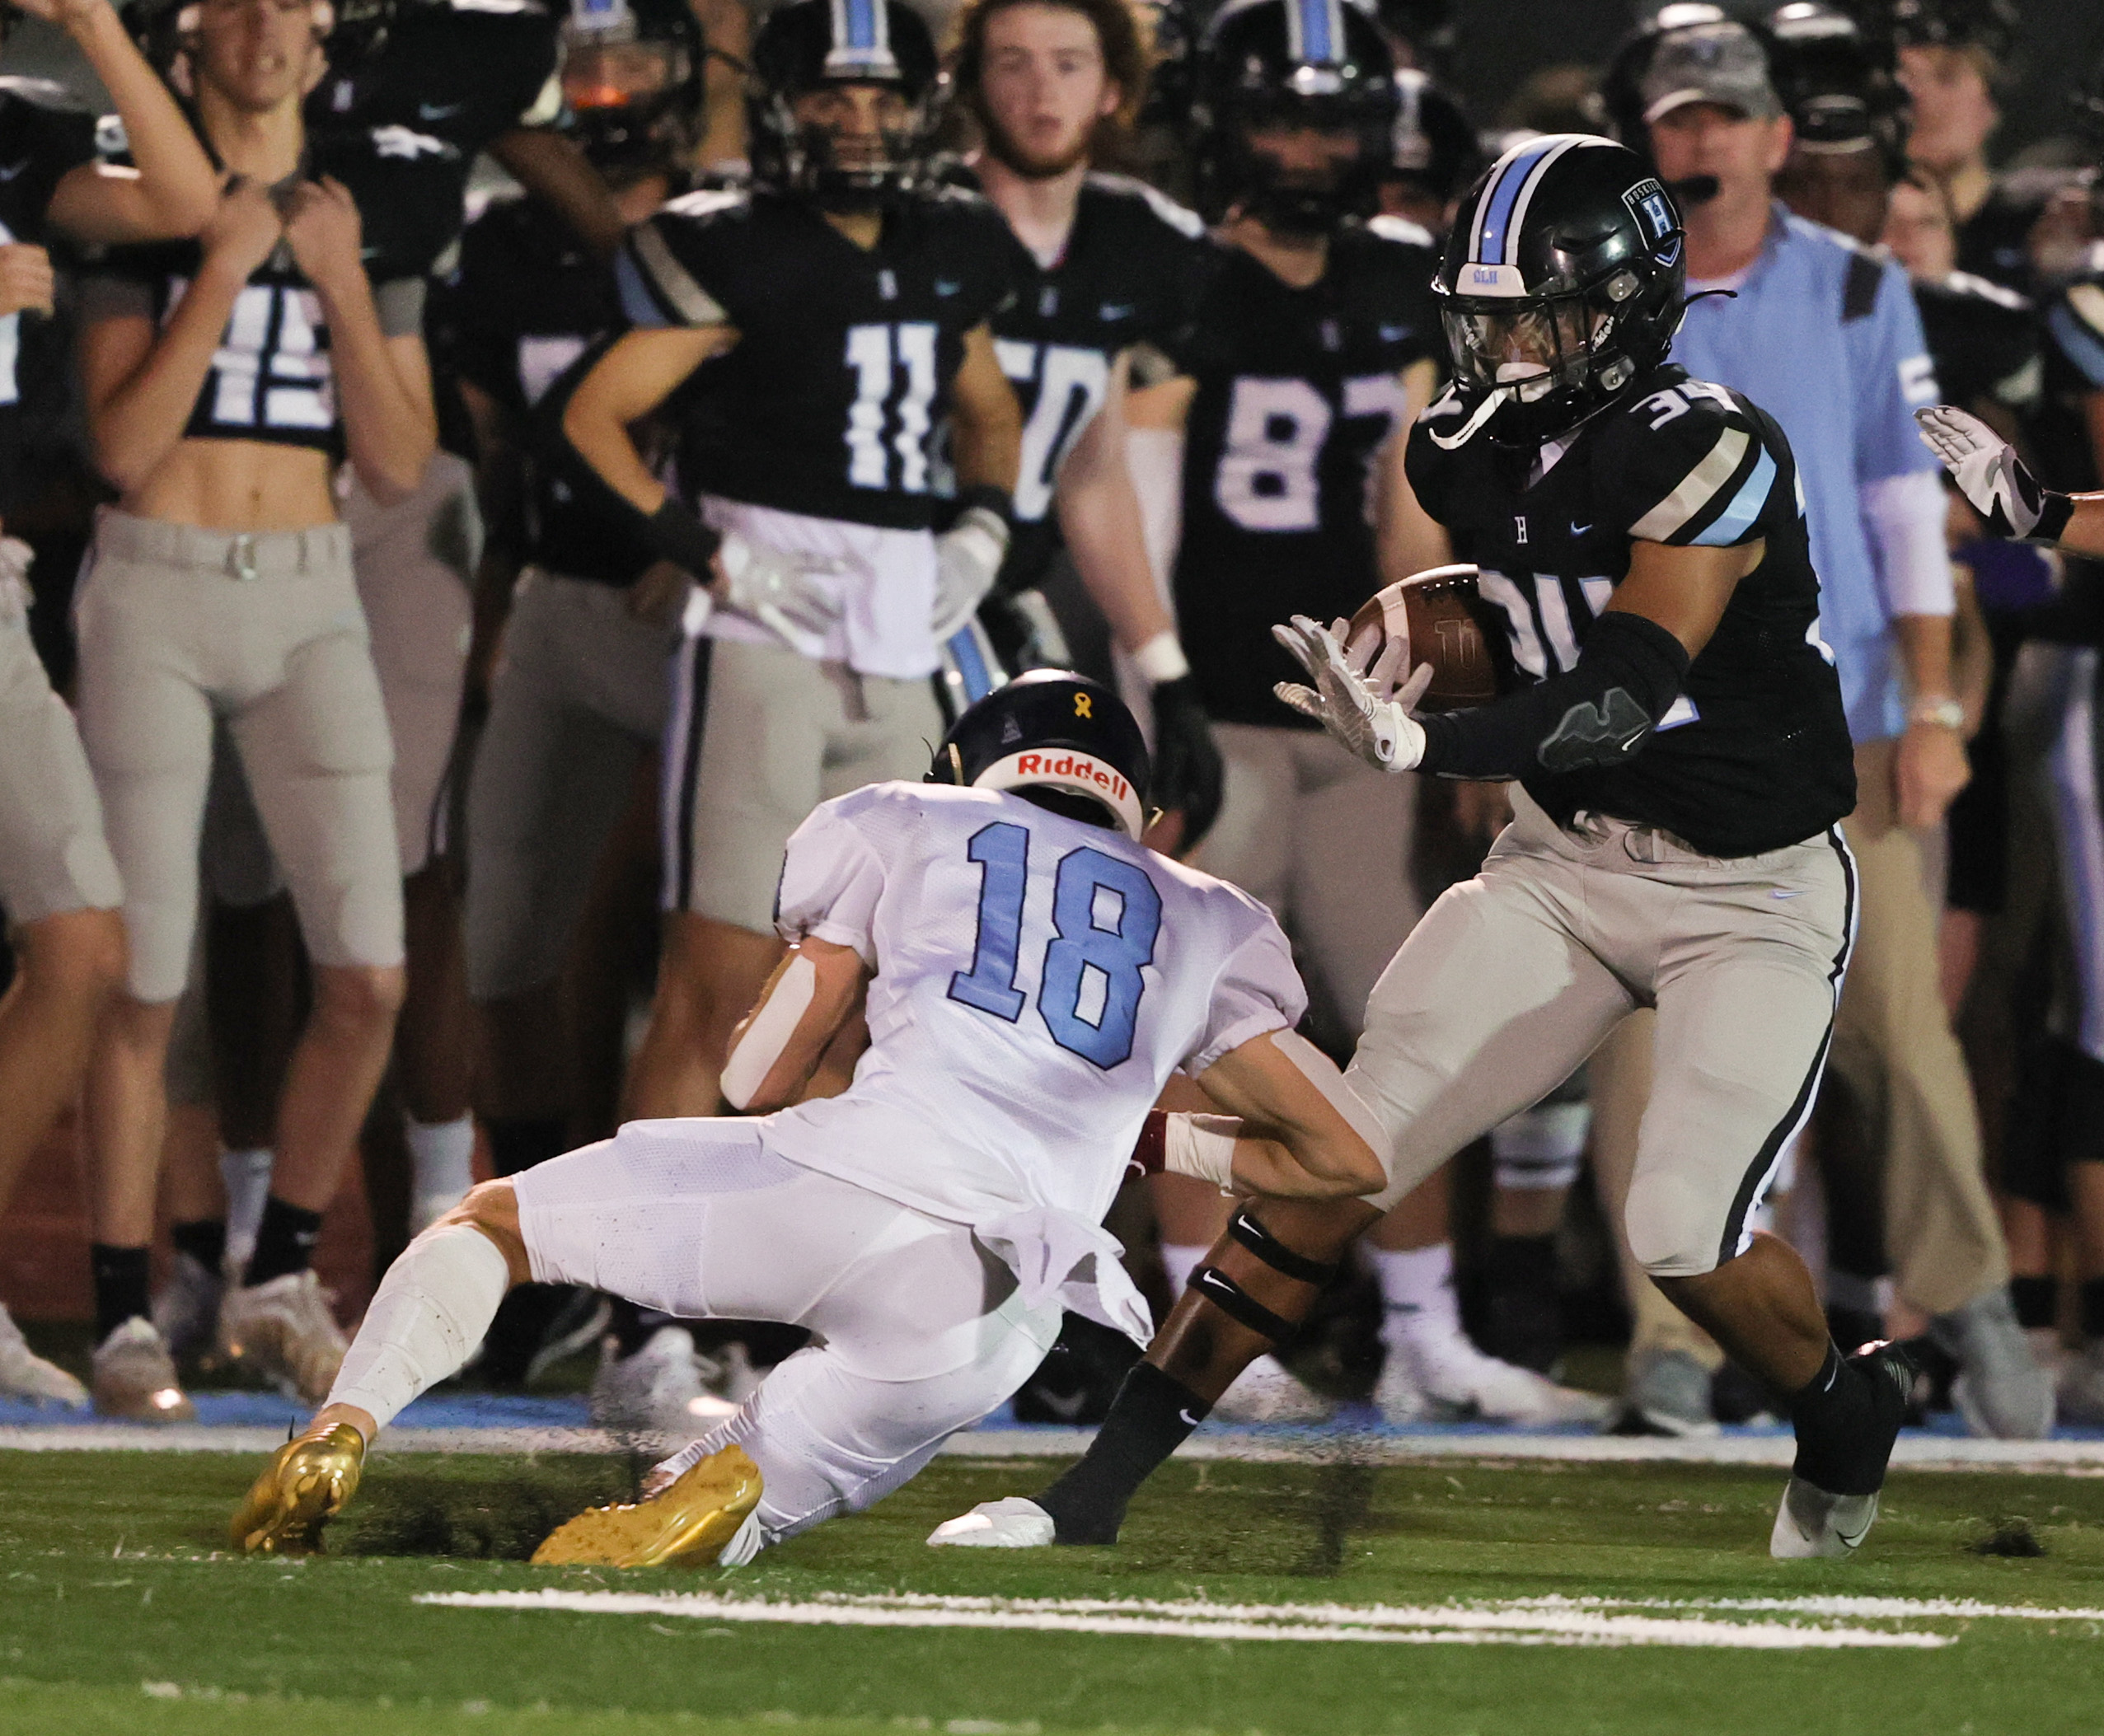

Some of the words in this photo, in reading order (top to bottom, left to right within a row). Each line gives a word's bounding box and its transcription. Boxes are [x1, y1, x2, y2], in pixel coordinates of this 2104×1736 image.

[1639, 192, 1674, 241] H
[843, 322, 939, 492] 11
[1216, 374, 1406, 531] 87
[1514, 515, 1529, 545] H
[1018, 753, 1128, 802] Riddell
[946, 821, 1164, 1072] 18
